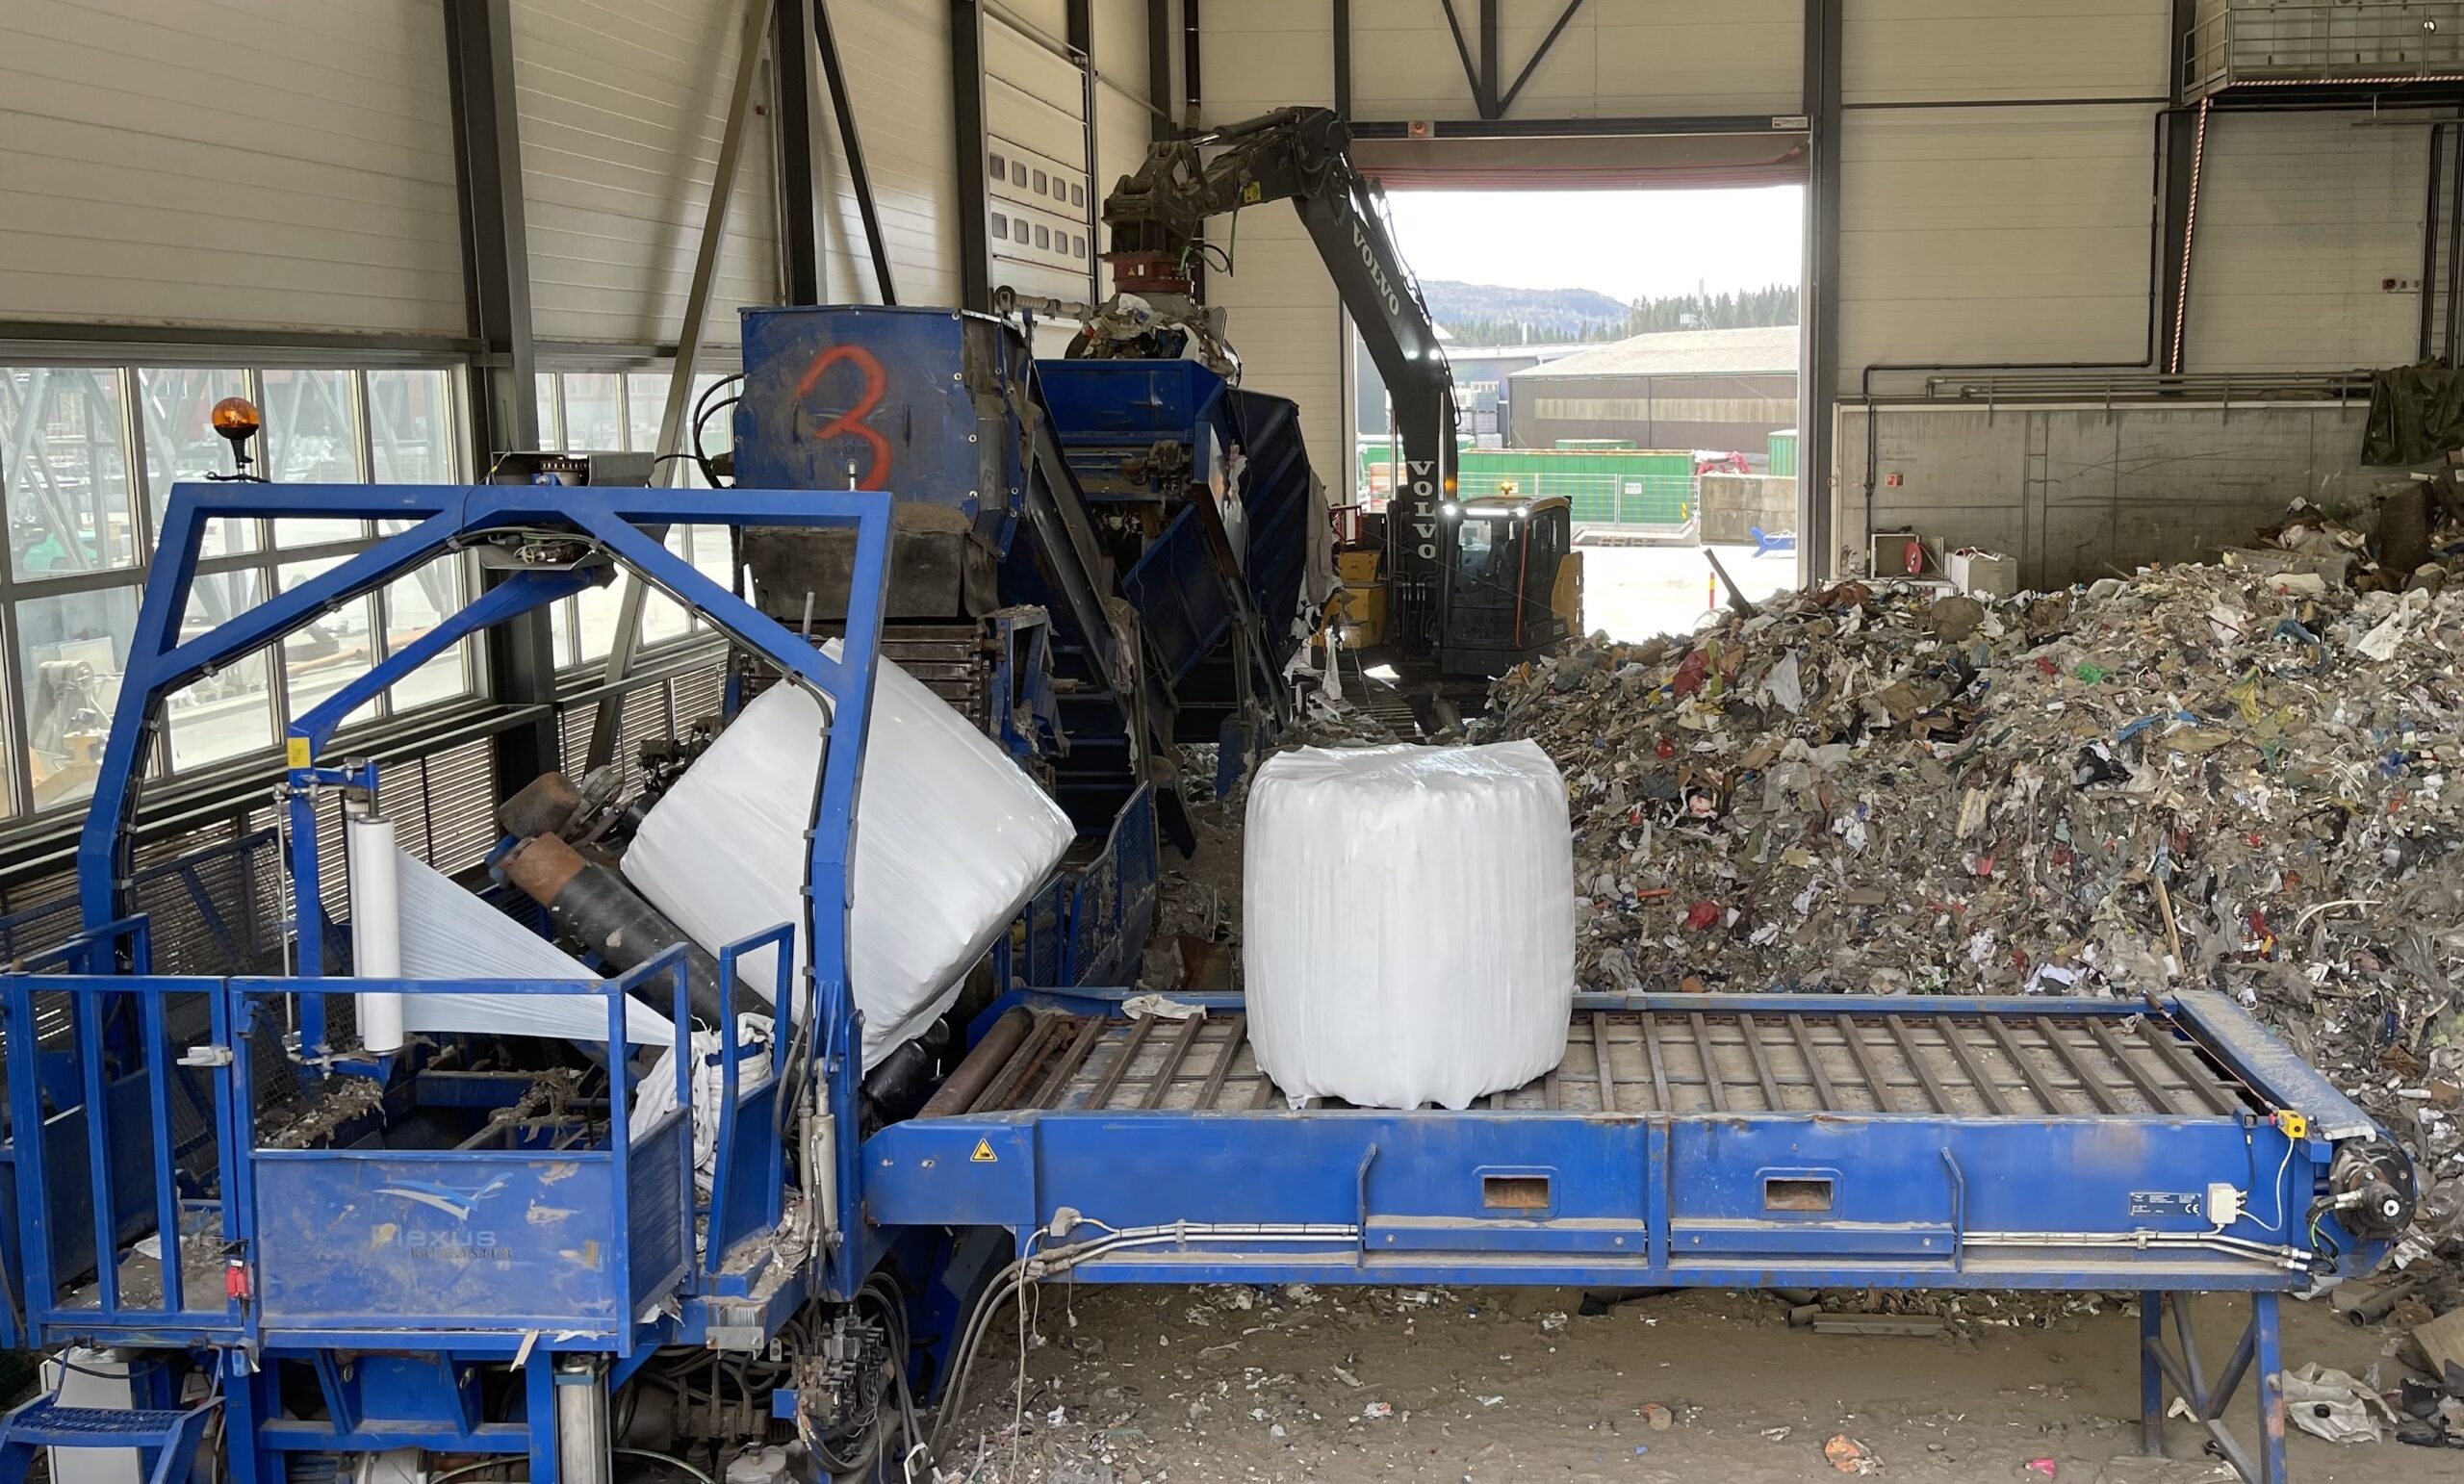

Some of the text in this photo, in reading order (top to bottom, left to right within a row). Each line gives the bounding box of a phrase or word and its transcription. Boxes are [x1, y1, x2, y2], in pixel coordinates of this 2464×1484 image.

[1353, 219, 1399, 316] VOLVO
[794, 345, 892, 491] 3
[1407, 460, 1437, 559] VOLVO
